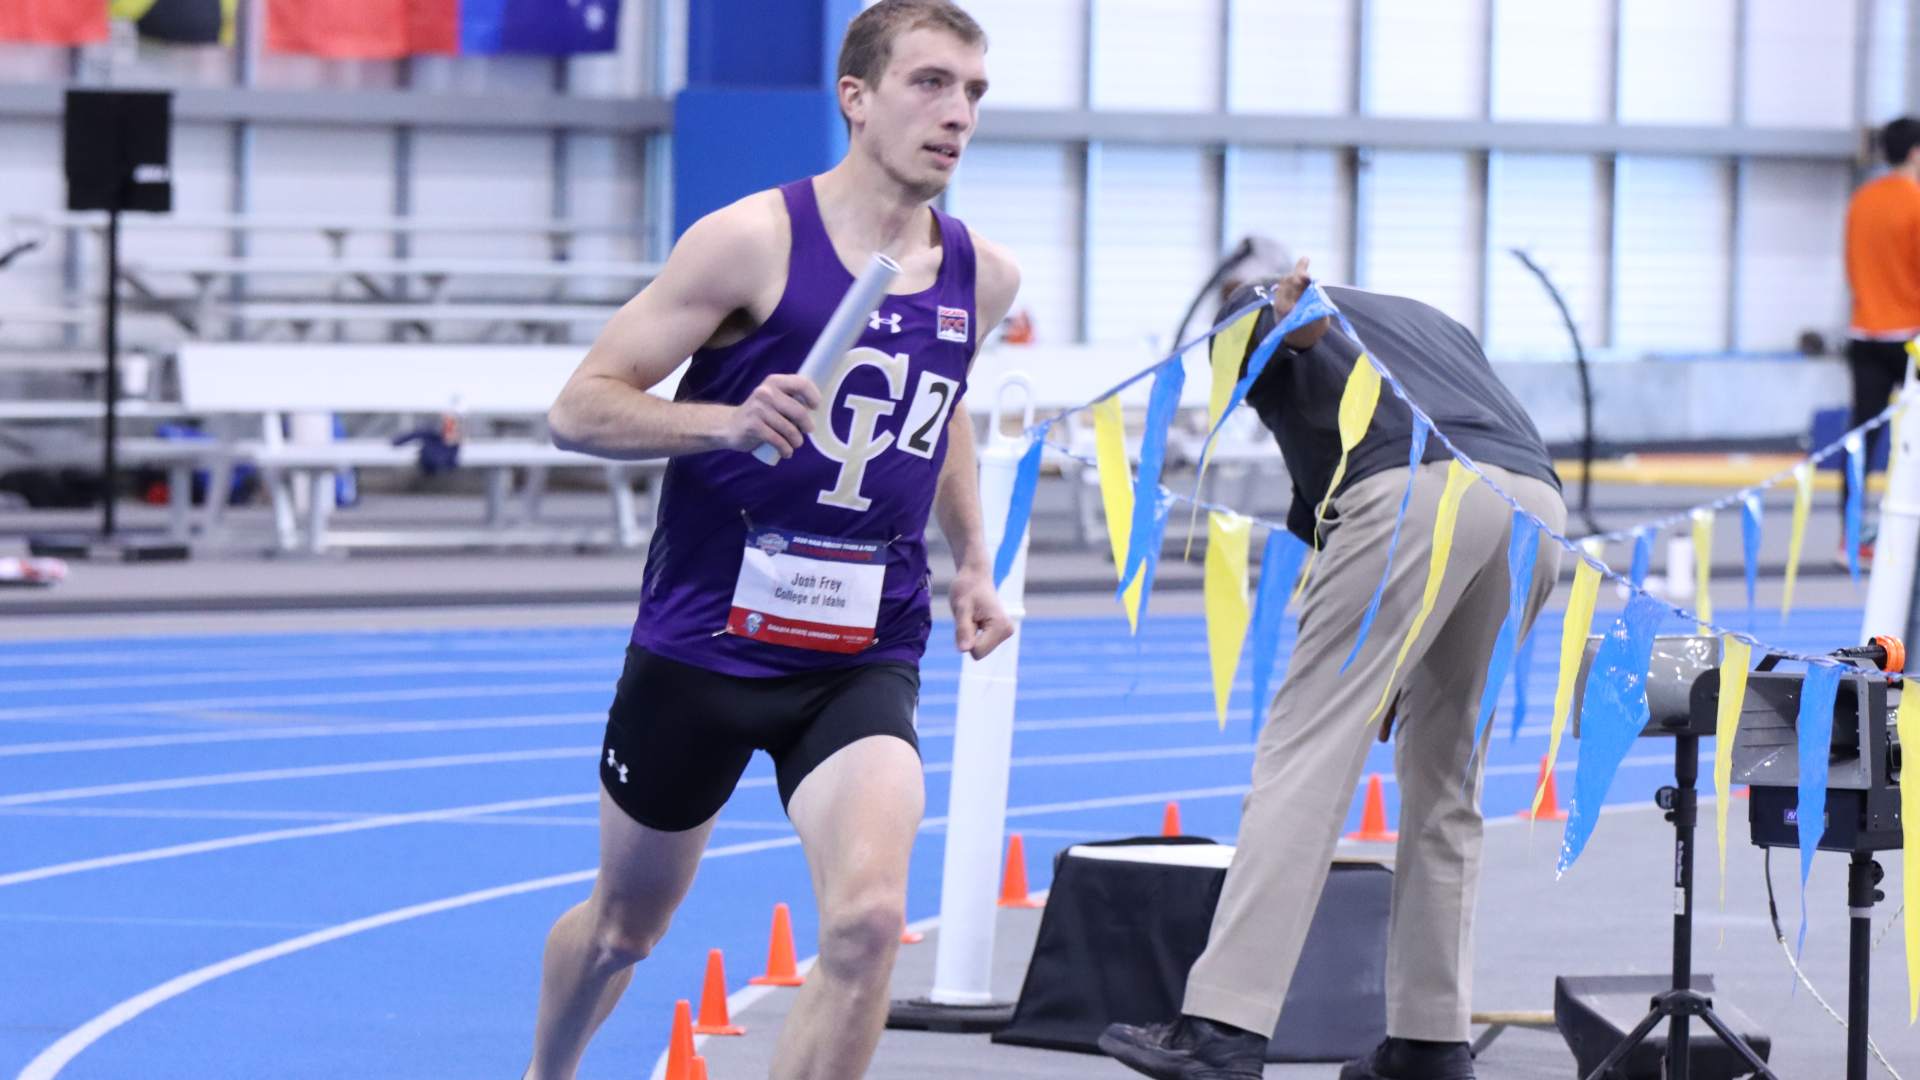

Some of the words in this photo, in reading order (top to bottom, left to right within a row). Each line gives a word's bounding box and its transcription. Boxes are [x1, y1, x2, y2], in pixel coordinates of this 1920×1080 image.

[908, 381, 949, 453] 2
[791, 572, 816, 588] Josh
[819, 576, 842, 592] Frey
[774, 587, 808, 605] College
[811, 593, 820, 605] of
[822, 595, 846, 608] Idaho
